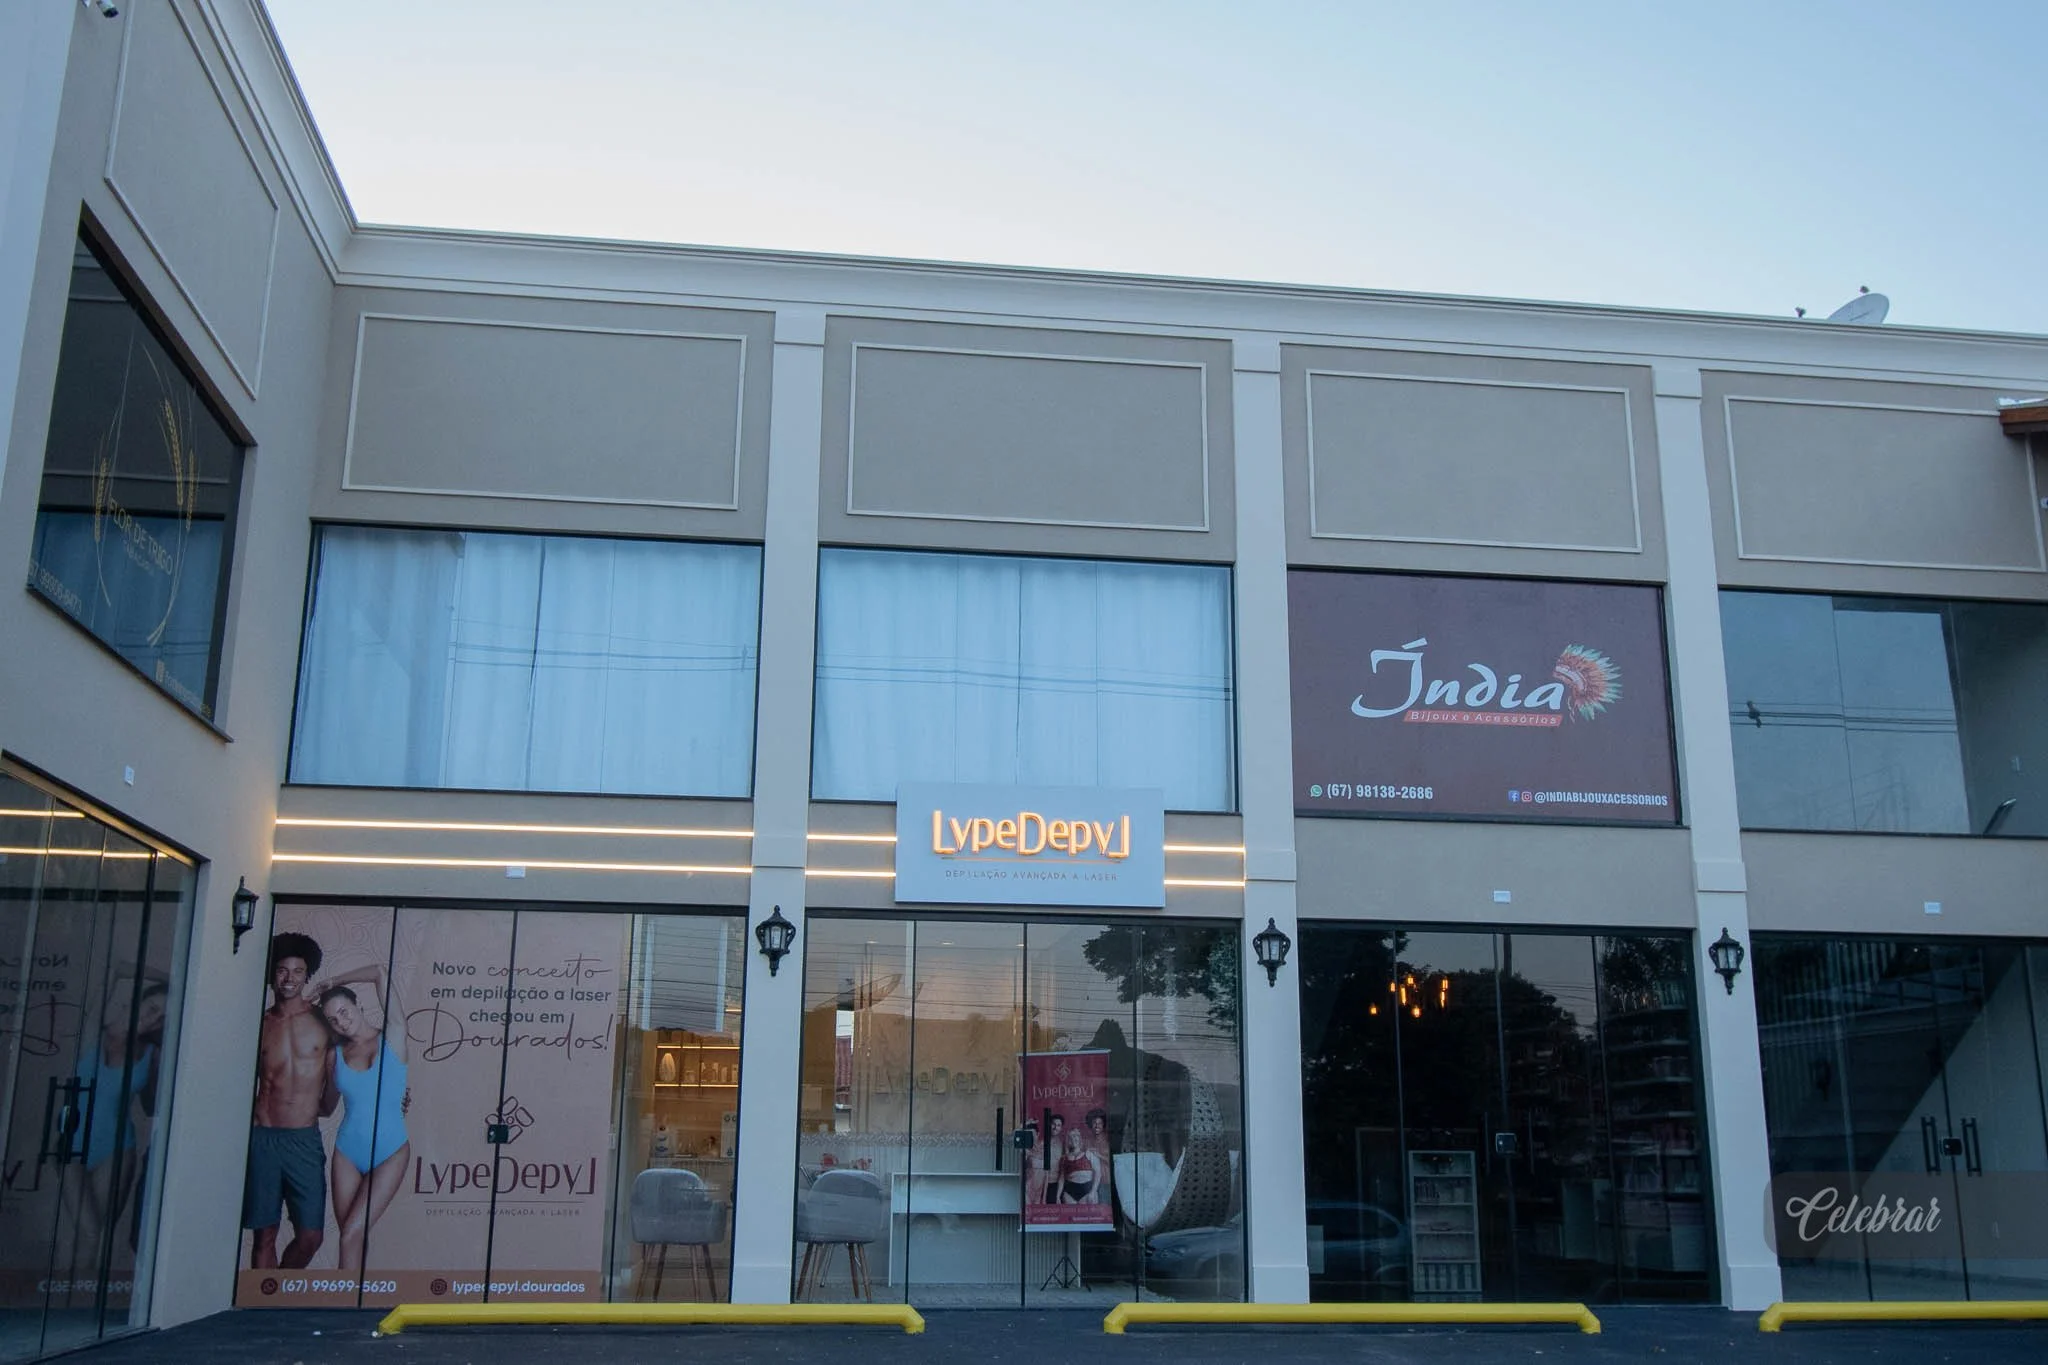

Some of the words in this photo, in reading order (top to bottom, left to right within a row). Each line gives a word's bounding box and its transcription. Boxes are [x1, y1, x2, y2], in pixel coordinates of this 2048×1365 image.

[1351, 637, 1565, 718] Índia
[1411, 711, 1458, 722] Bijoux
[1474, 713, 1558, 725] Acessórios
[1327, 783, 1352, 800] (67)
[1356, 785, 1434, 800] 98138-2686
[1534, 791, 1668, 806] @INDIABIJOUXACESSORIOS
[945, 868, 1008, 881] DEPILAÇÃO
[1013, 871, 1068, 882] AVANÇADA
[1073, 873, 1080, 881] A
[1085, 874, 1118, 882] LASER
[432, 962, 477, 976] Novo
[487, 953, 613, 986] conceito
[430, 988, 456, 999] em
[462, 985, 549, 1003] depilação
[554, 992, 565, 1001] a
[570, 988, 612, 1001] laser
[469, 1008, 534, 1026] chegou
[540, 1013, 565, 1023] em
[406, 1001, 614, 1062] Dourados!
[281, 1279, 308, 1293] (67)
[312, 1280, 397, 1293] 99699-5620
